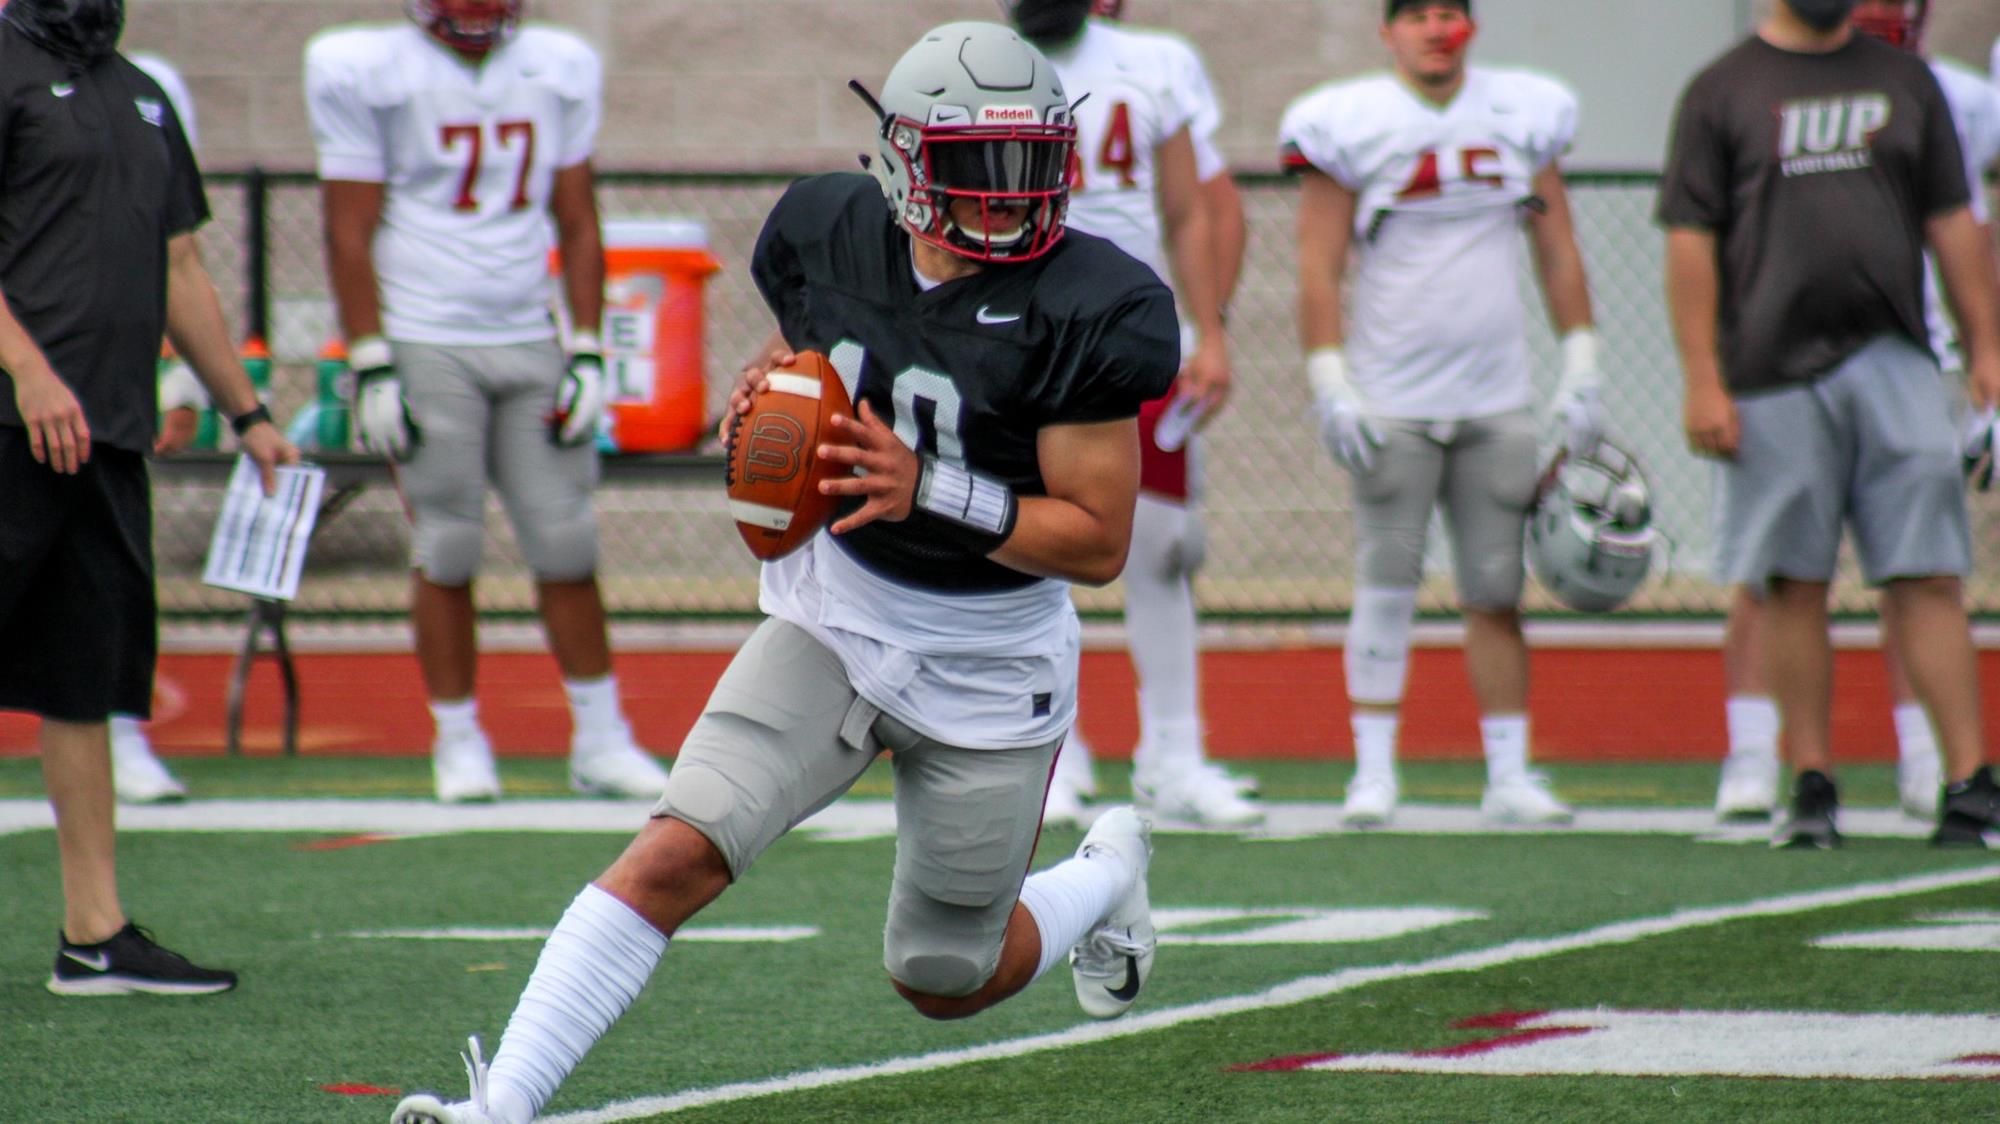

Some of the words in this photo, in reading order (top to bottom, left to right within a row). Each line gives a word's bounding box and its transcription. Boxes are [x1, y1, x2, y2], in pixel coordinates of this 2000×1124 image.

[984, 109, 1034, 120] Riddell
[1777, 93, 1888, 158] IUP
[439, 121, 534, 213] 77
[1780, 149, 1870, 178] FOOTBALL
